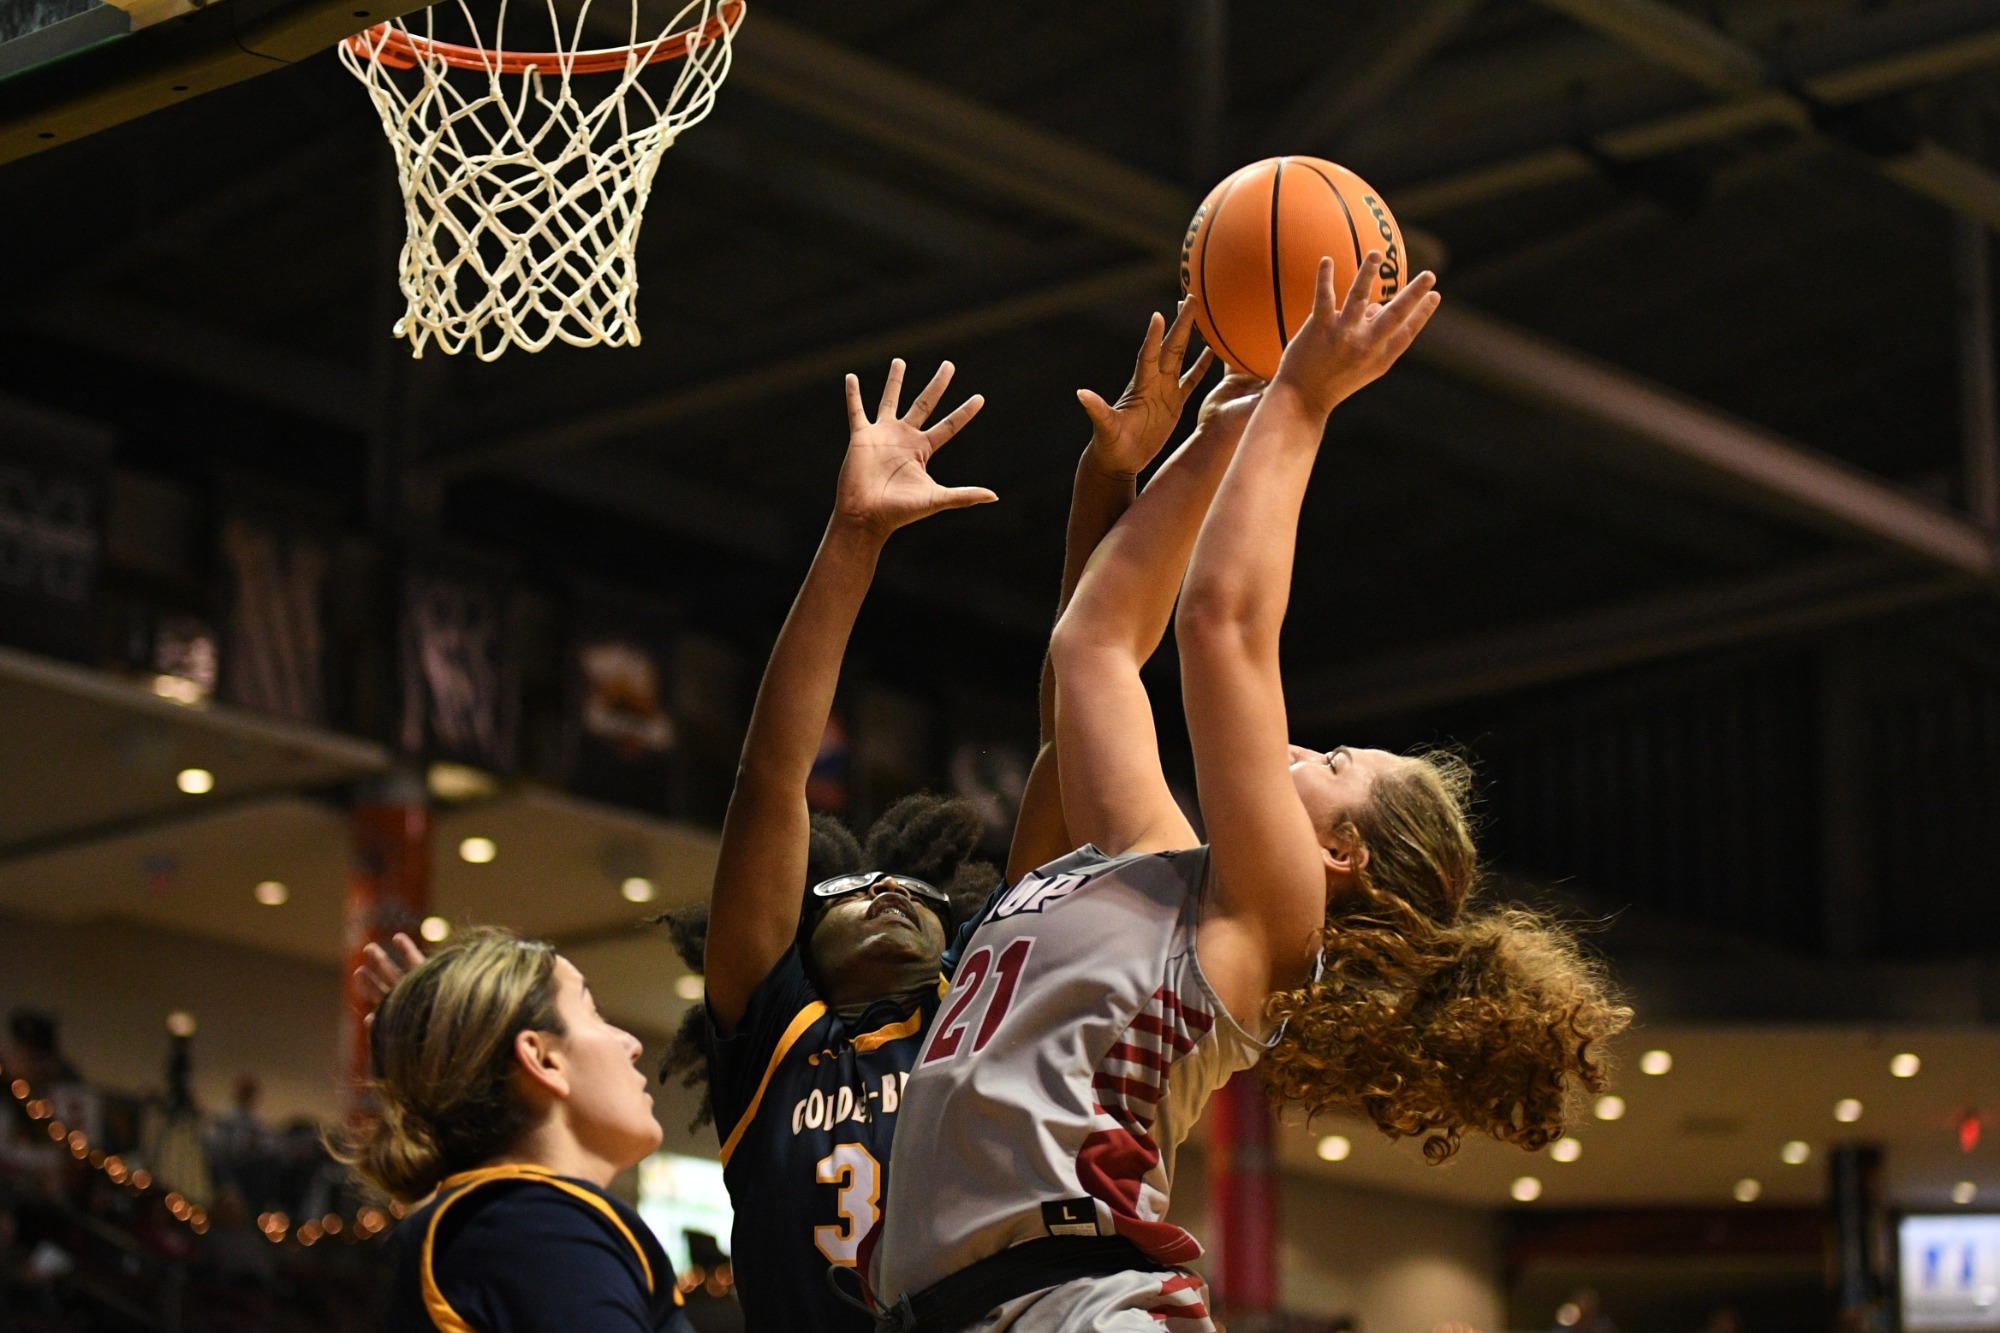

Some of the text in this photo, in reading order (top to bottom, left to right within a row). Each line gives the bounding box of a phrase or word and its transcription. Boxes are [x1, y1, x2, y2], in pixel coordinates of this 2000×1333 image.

[1363, 196, 1399, 305] ilson
[919, 936, 1037, 1069] 21
[814, 1142, 880, 1268] 3
[1062, 1205, 1077, 1221] L
